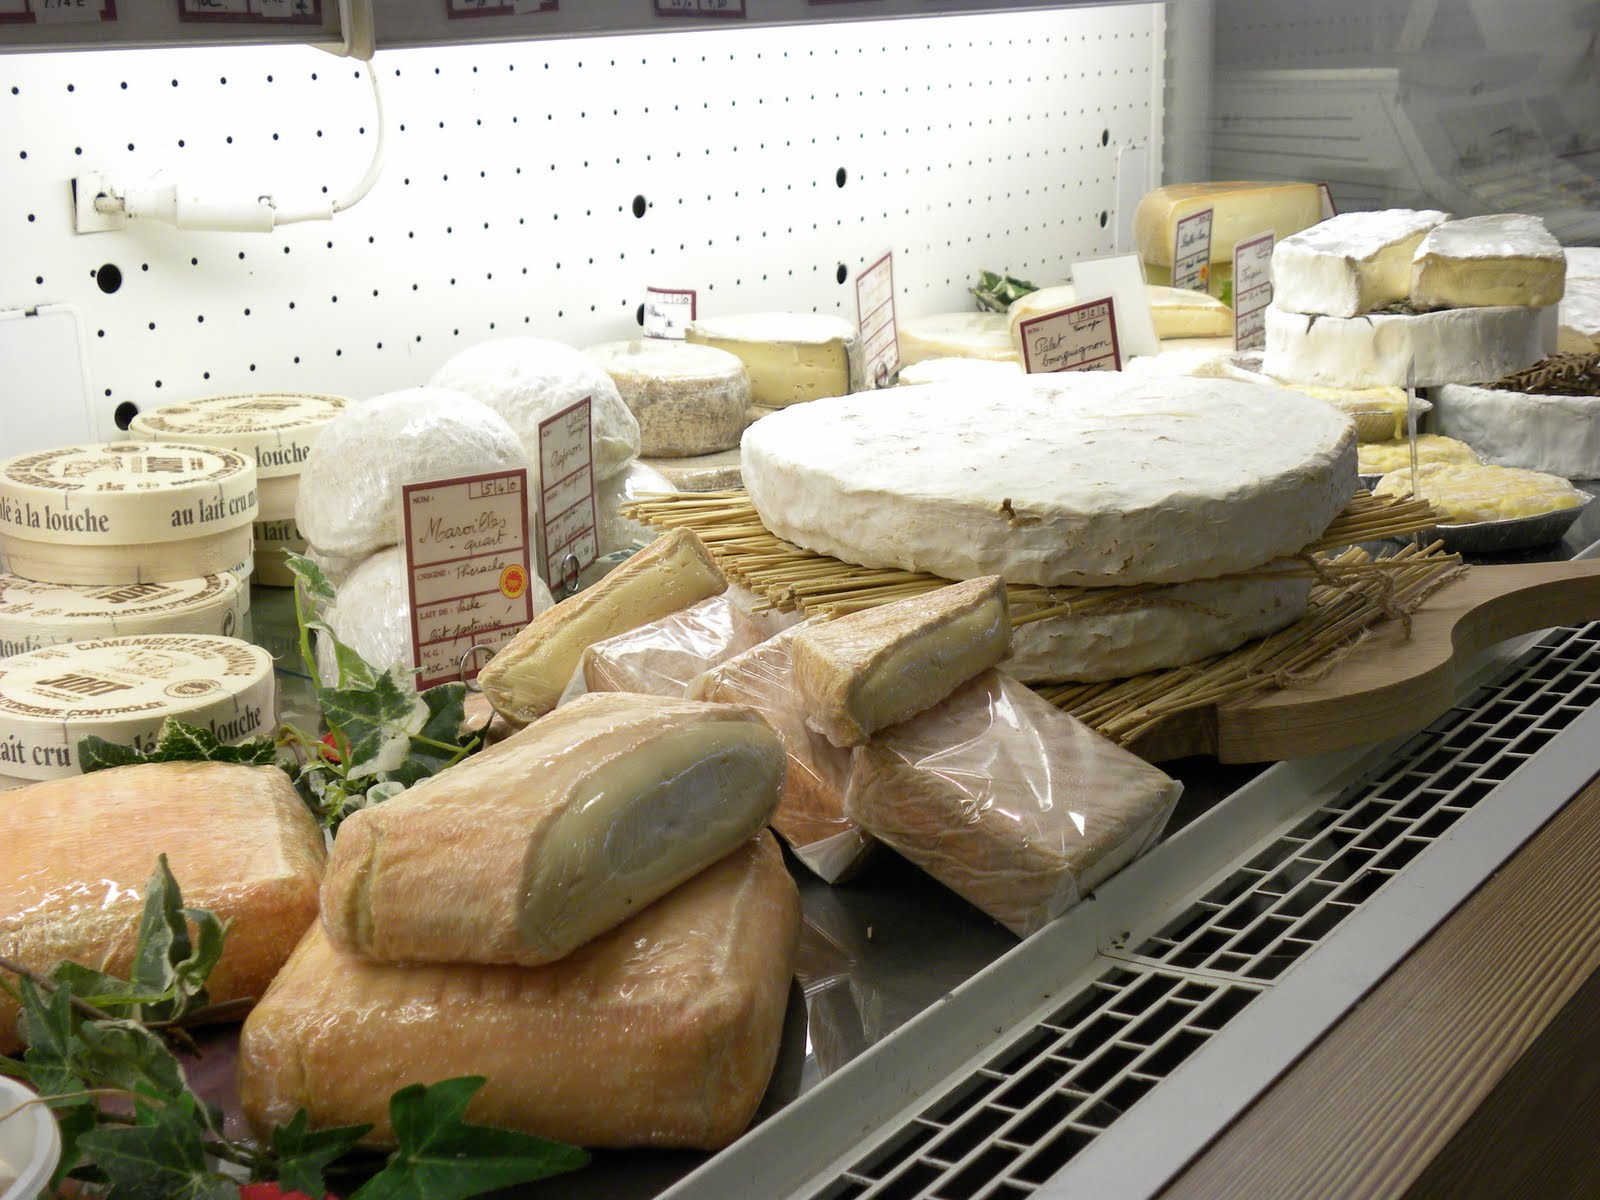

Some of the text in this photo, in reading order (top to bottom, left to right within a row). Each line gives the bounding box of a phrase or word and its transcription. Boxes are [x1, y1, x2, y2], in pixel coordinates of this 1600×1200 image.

[1035, 333, 1067, 356] Palet
[1042, 340, 1111, 367] bourguignon
[255, 441, 310, 468] louche
[15, 499, 22, 526] à
[26, 502, 40, 528] la
[45, 504, 110, 533] louche
[171, 507, 194, 527] au
[198, 495, 225, 523] lait
[229, 493, 247, 516] cru
[417, 569, 447, 581] ORIGINE
[420, 609, 437, 620] LAIT
[75, 637, 197, 650] CAMEMBERT
[36, 673, 133, 697] JORT
[209, 705, 261, 743] louche
[0, 734, 72, 768] ait cru
